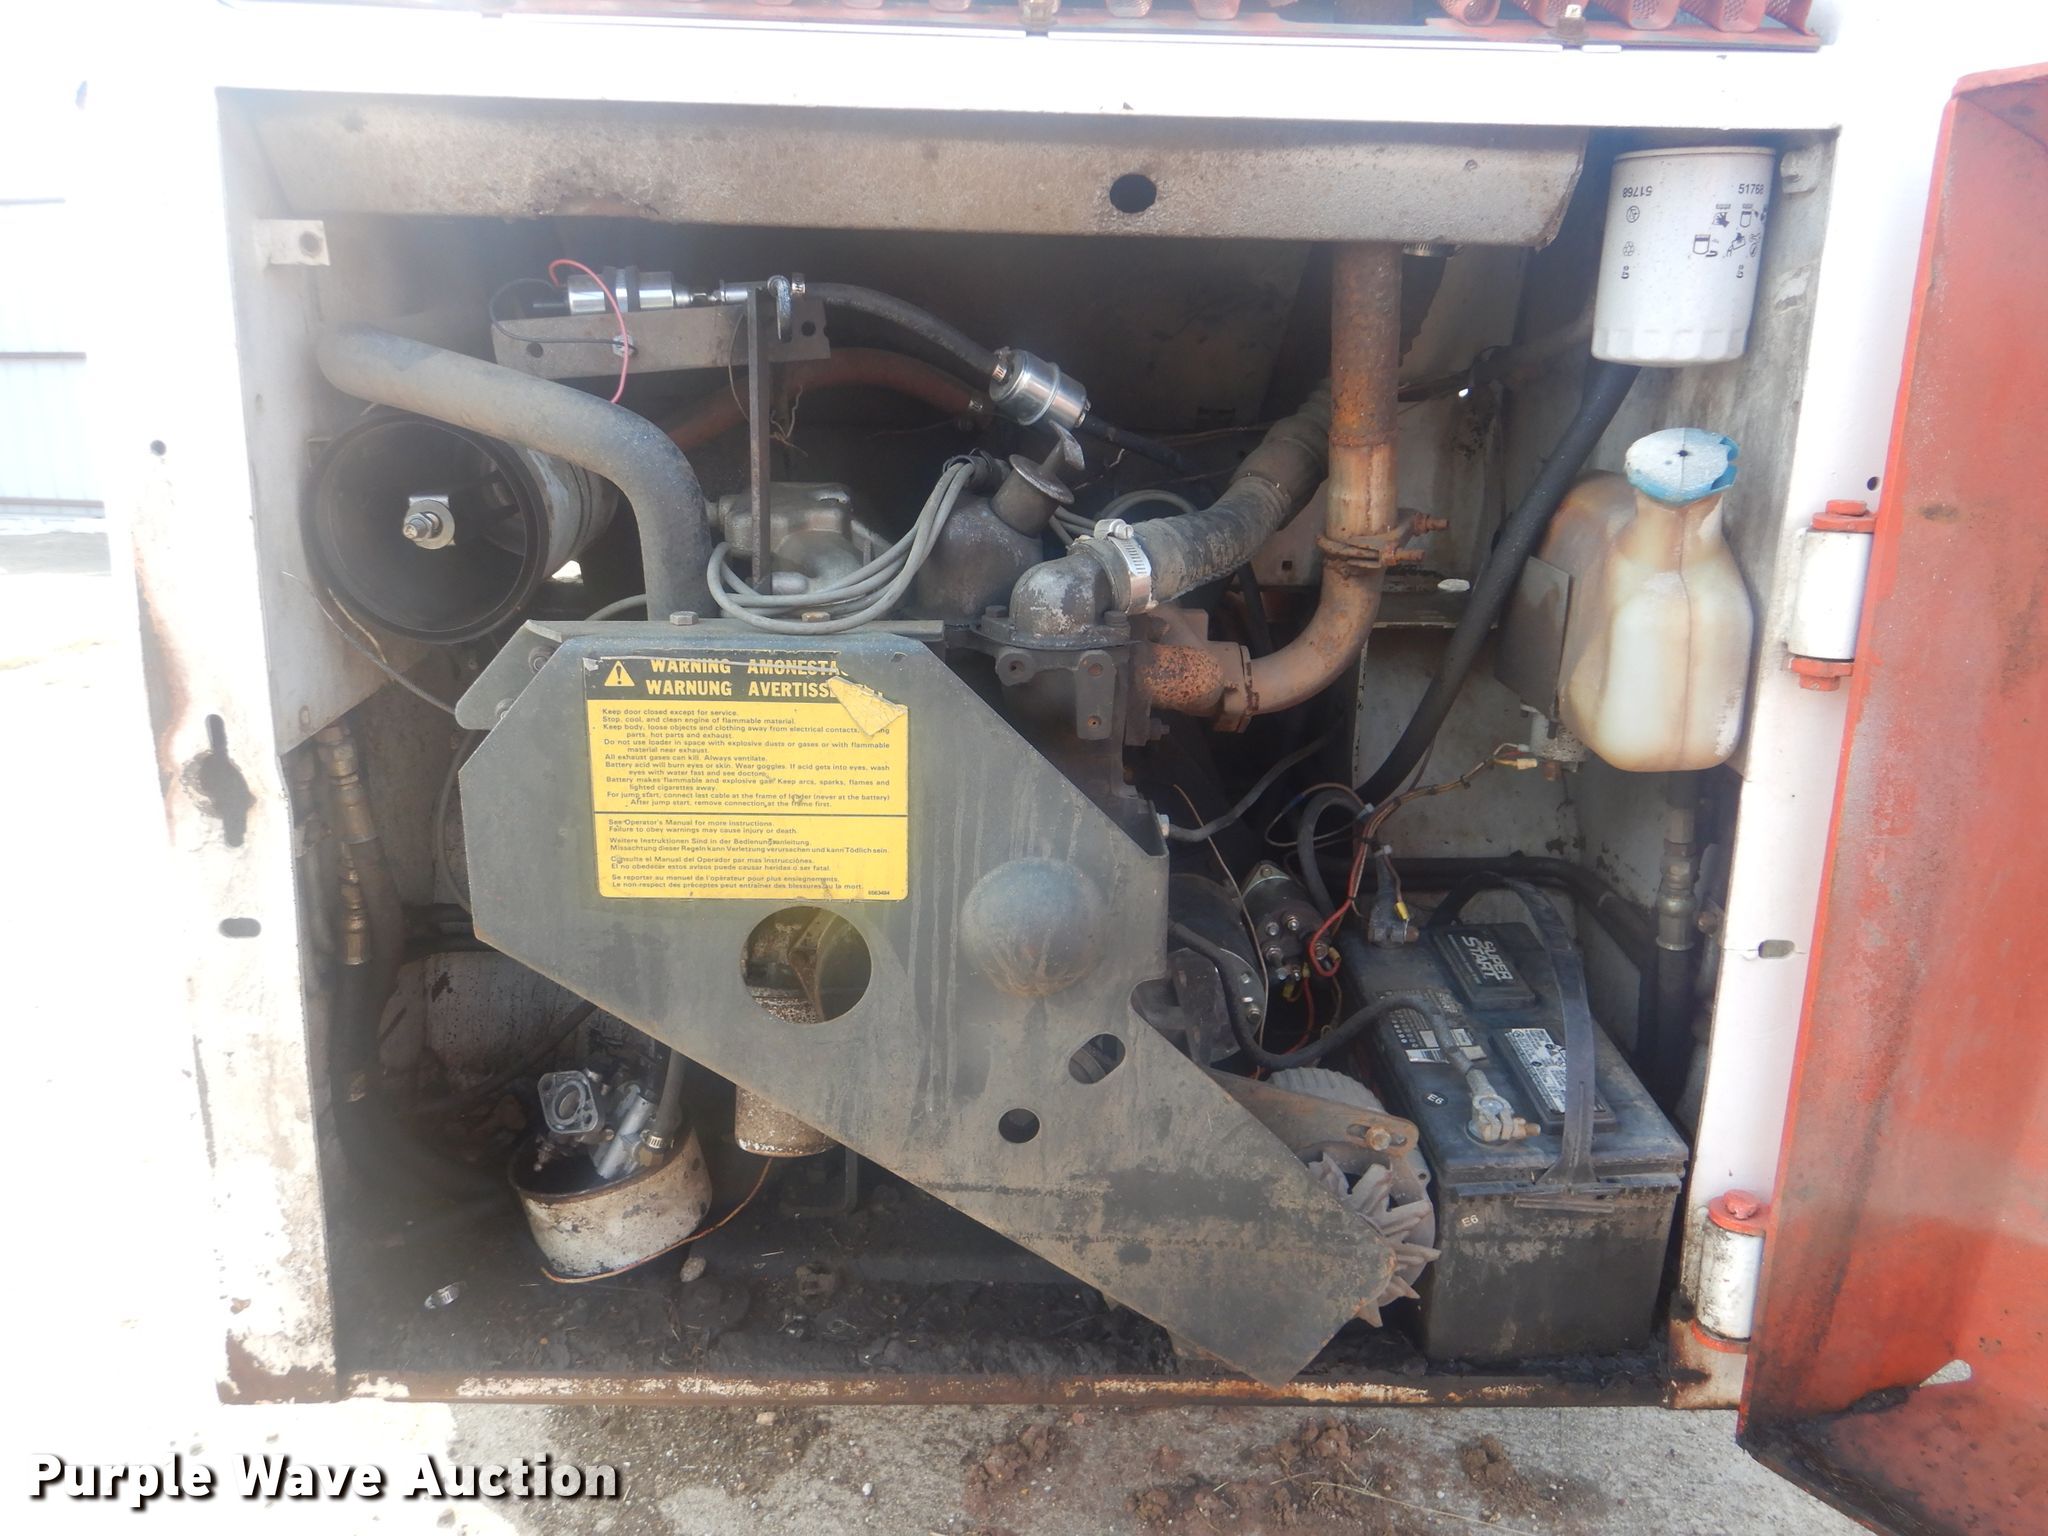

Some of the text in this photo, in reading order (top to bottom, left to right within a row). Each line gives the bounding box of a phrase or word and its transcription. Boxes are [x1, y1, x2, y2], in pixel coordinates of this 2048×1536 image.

[651, 658, 731, 674] WARNING
[646, 680, 732, 696] WARNUNG
[1461, 936, 1501, 980] START
[1484, 940, 1514, 980] SUPER
[1427, 1093, 1444, 1105] E6
[1461, 1214, 1479, 1228] E6
